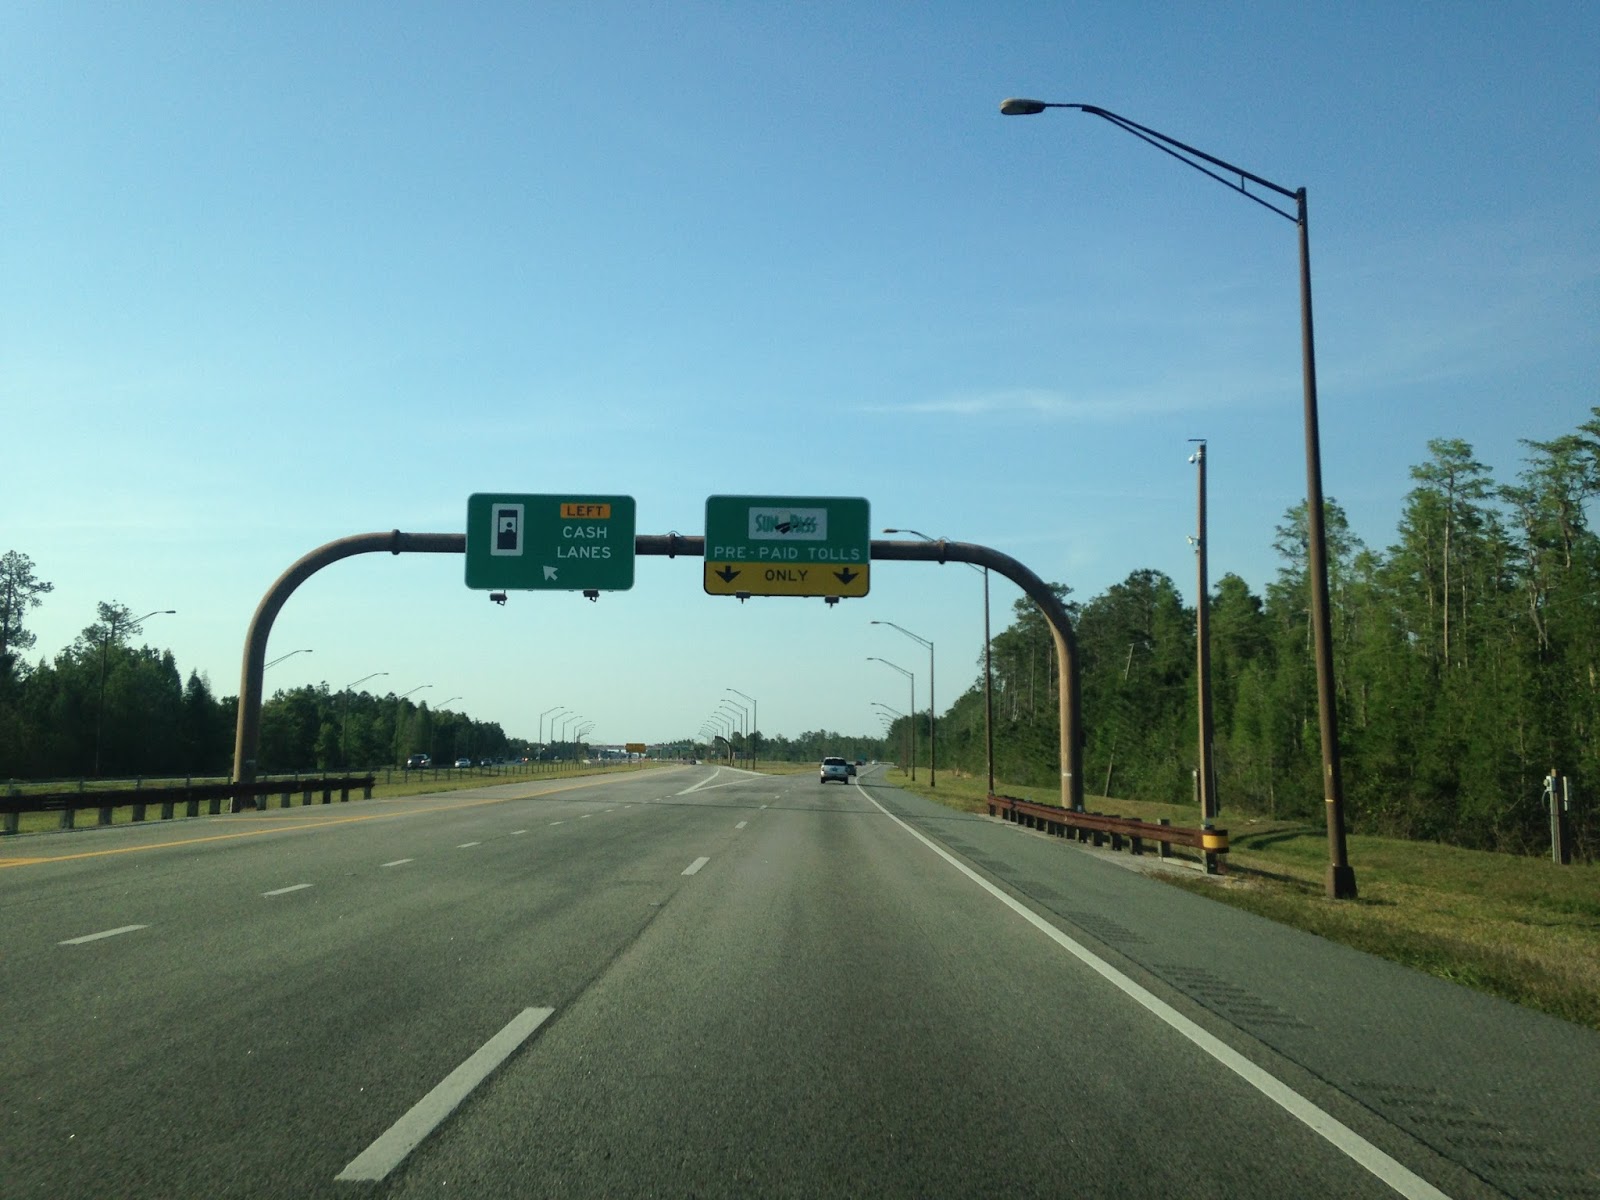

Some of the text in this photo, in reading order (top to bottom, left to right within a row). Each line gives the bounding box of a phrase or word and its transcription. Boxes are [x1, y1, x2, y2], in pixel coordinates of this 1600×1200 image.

[567, 504, 604, 517] LEFT
[562, 526, 607, 539] CASH
[557, 546, 611, 559] LANES
[808, 548, 861, 560] TOLLS
[765, 570, 808, 582] ONLY
